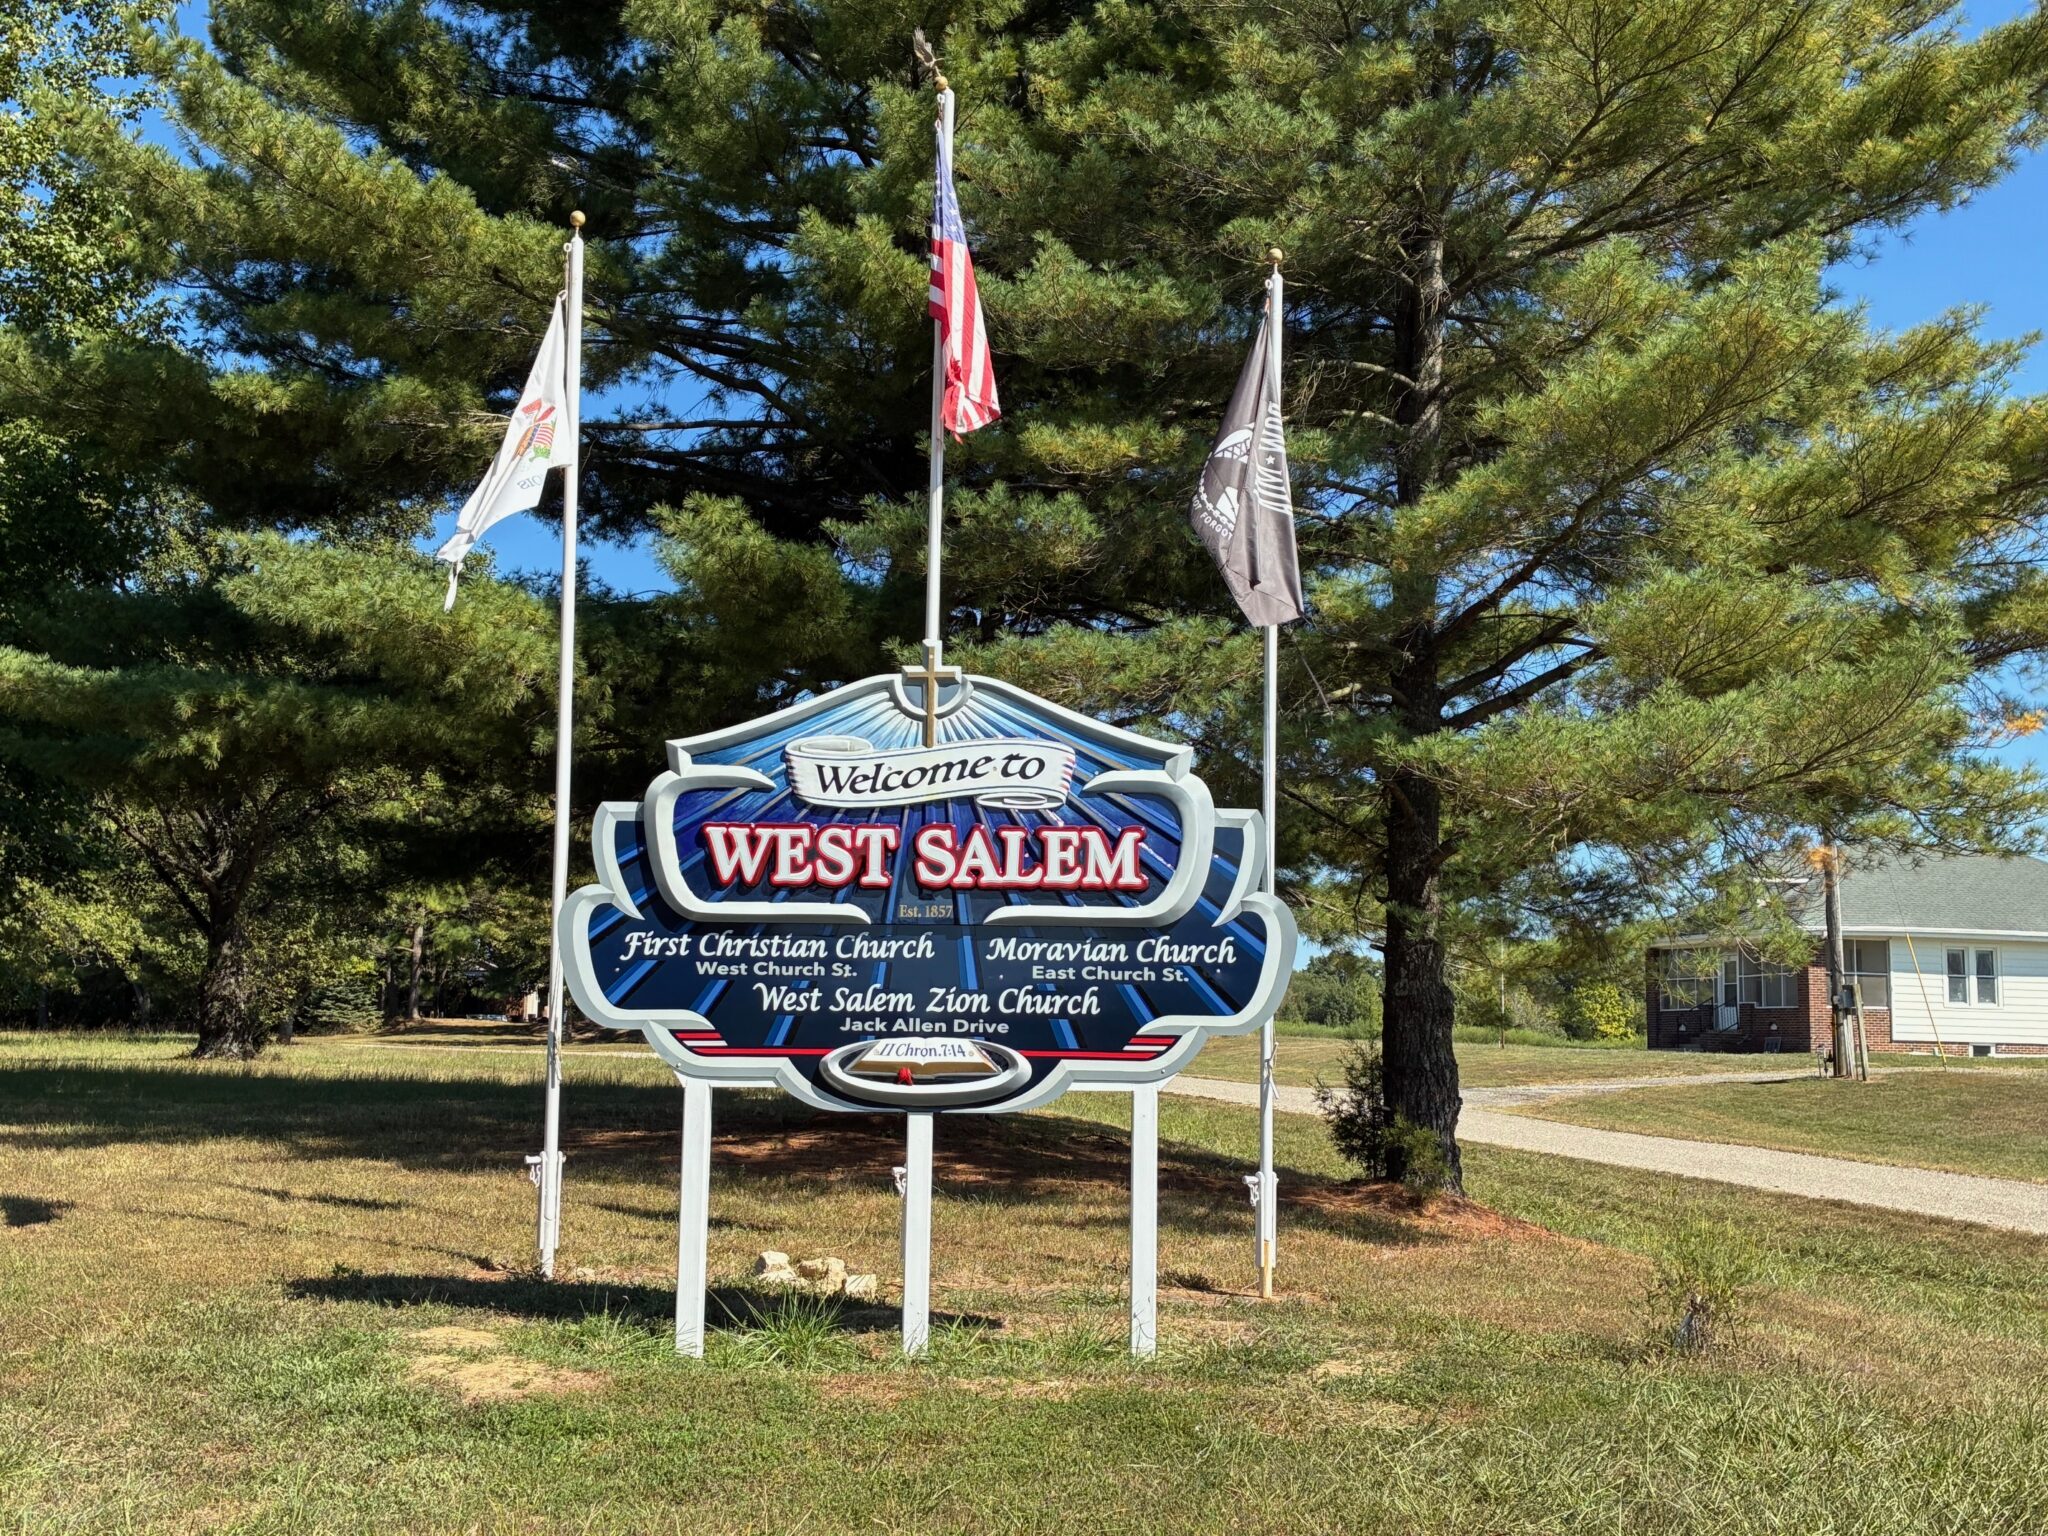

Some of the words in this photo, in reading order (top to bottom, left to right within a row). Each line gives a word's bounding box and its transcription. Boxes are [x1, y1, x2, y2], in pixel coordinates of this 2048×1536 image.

[815, 755, 996, 795] Welcome
[1001, 753, 1046, 780] to
[703, 821, 900, 888] WEST
[914, 823, 1149, 891] SALEM
[899, 904, 922, 918] Est.
[925, 904, 954, 918] 1857
[619, 930, 692, 961] First
[700, 930, 828, 959] Christian
[835, 931, 935, 960] Church
[985, 937, 1128, 962] Moravian
[1136, 936, 1237, 964] Church
[696, 962, 748, 976] West
[753, 962, 826, 977] Church
[831, 963, 858, 977] St.
[1032, 965, 1076, 980] East
[1081, 966, 1156, 981] Church
[1162, 967, 1189, 982] St.
[752, 982, 821, 1012] West
[829, 983, 915, 1013] Salem
[926, 986, 991, 1013] Zion
[998, 985, 1101, 1015] Church
[840, 1017, 887, 1032] Jack
[891, 1018, 947, 1033] Allen
[953, 1019, 1009, 1034] Drive
